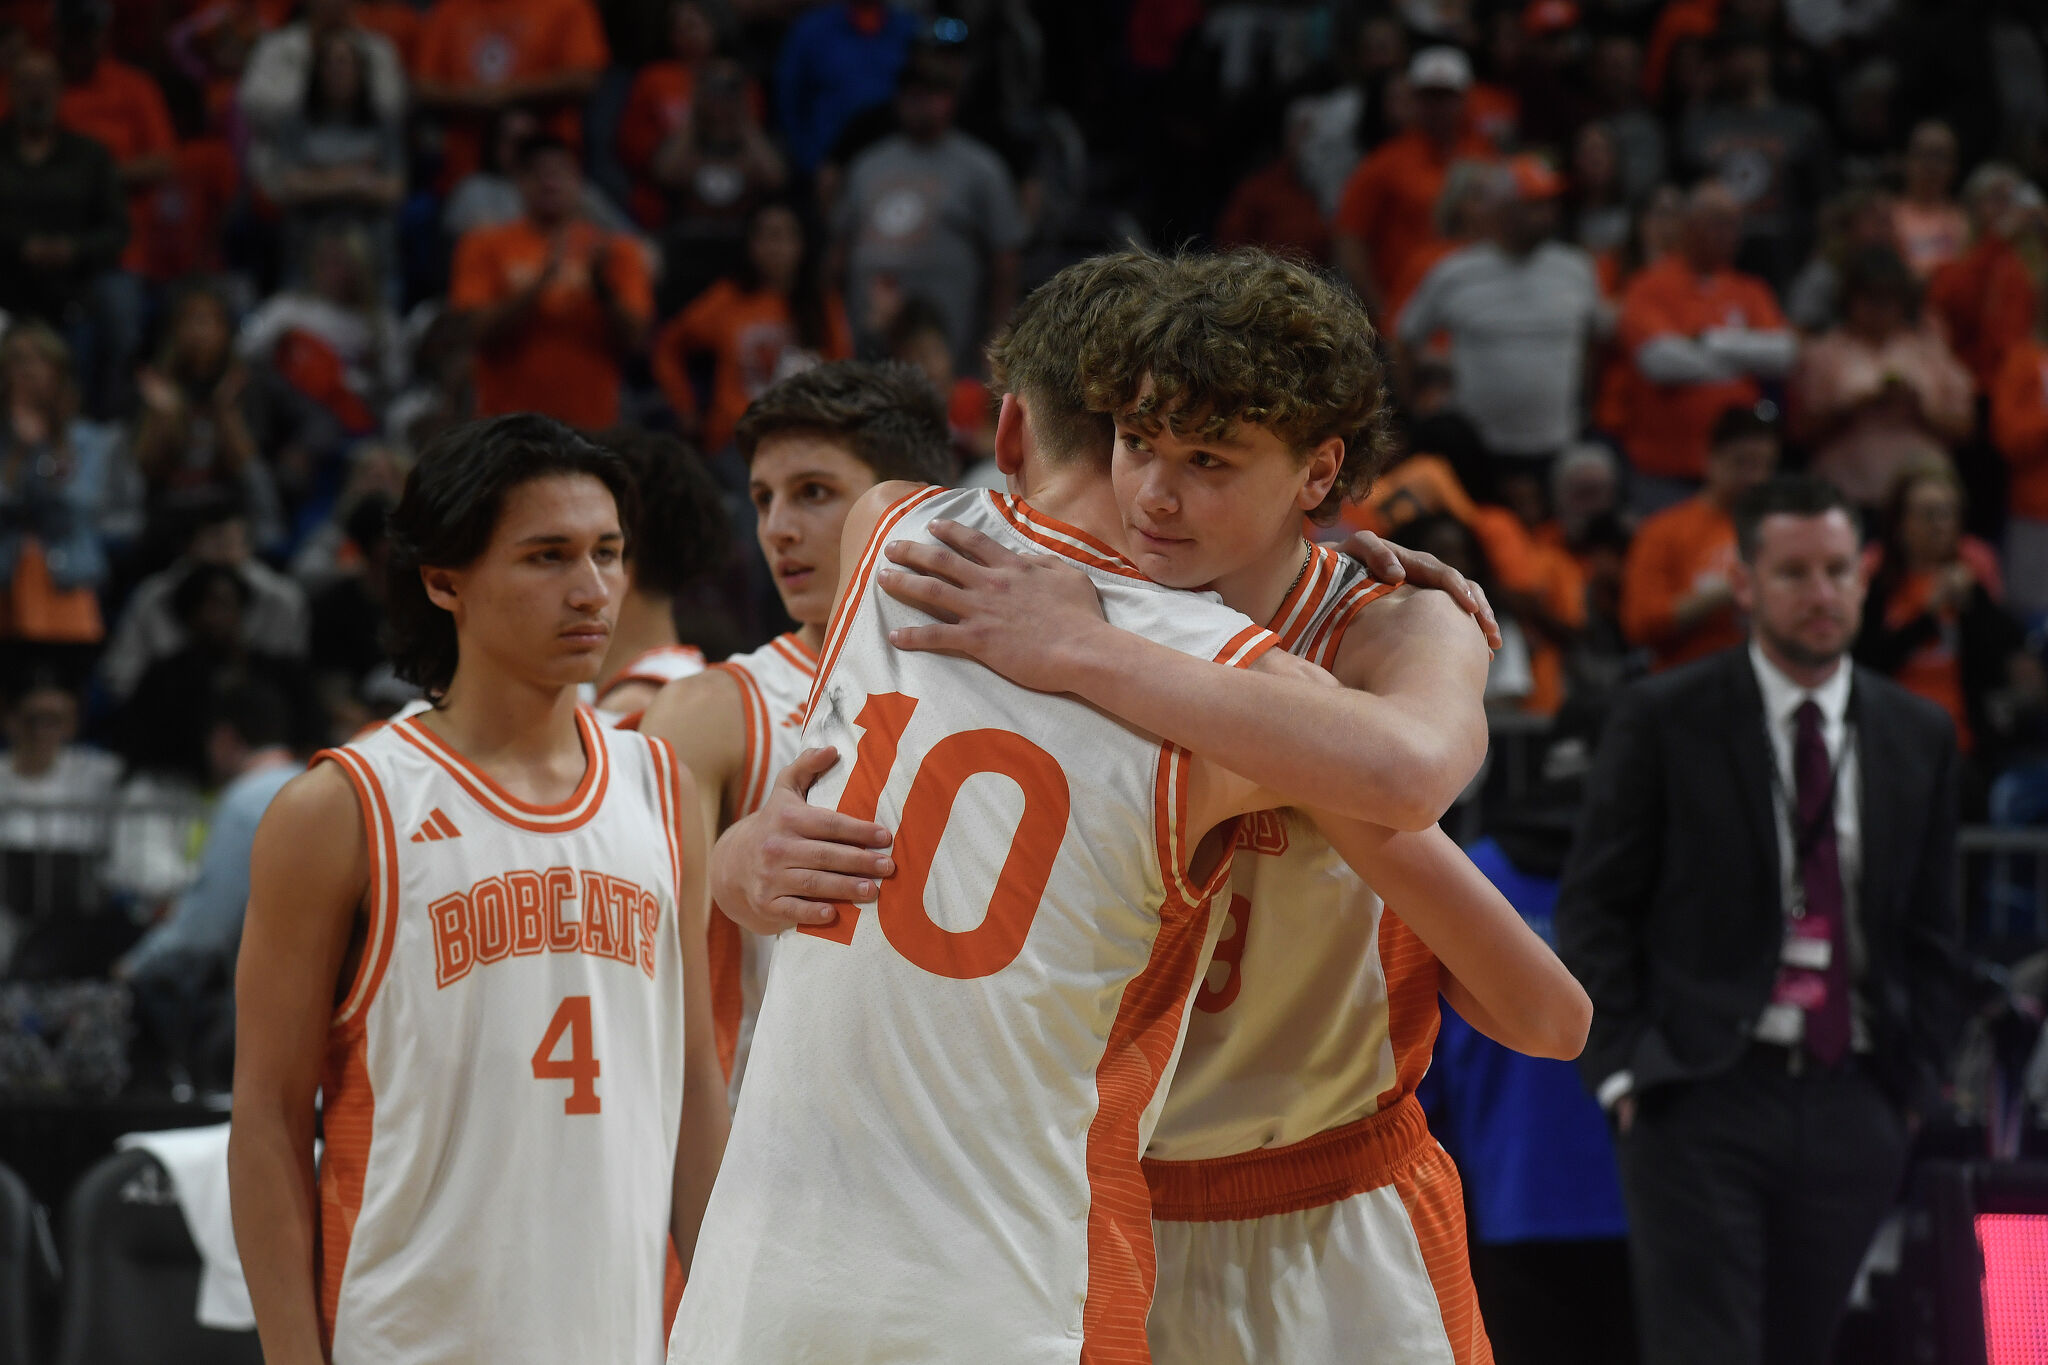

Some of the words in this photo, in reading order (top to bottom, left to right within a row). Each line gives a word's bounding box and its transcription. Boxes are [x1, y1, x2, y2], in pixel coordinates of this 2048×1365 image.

[796, 691, 1070, 979] 10
[428, 867, 660, 990] BOBCATS
[532, 996, 601, 1115] 4
